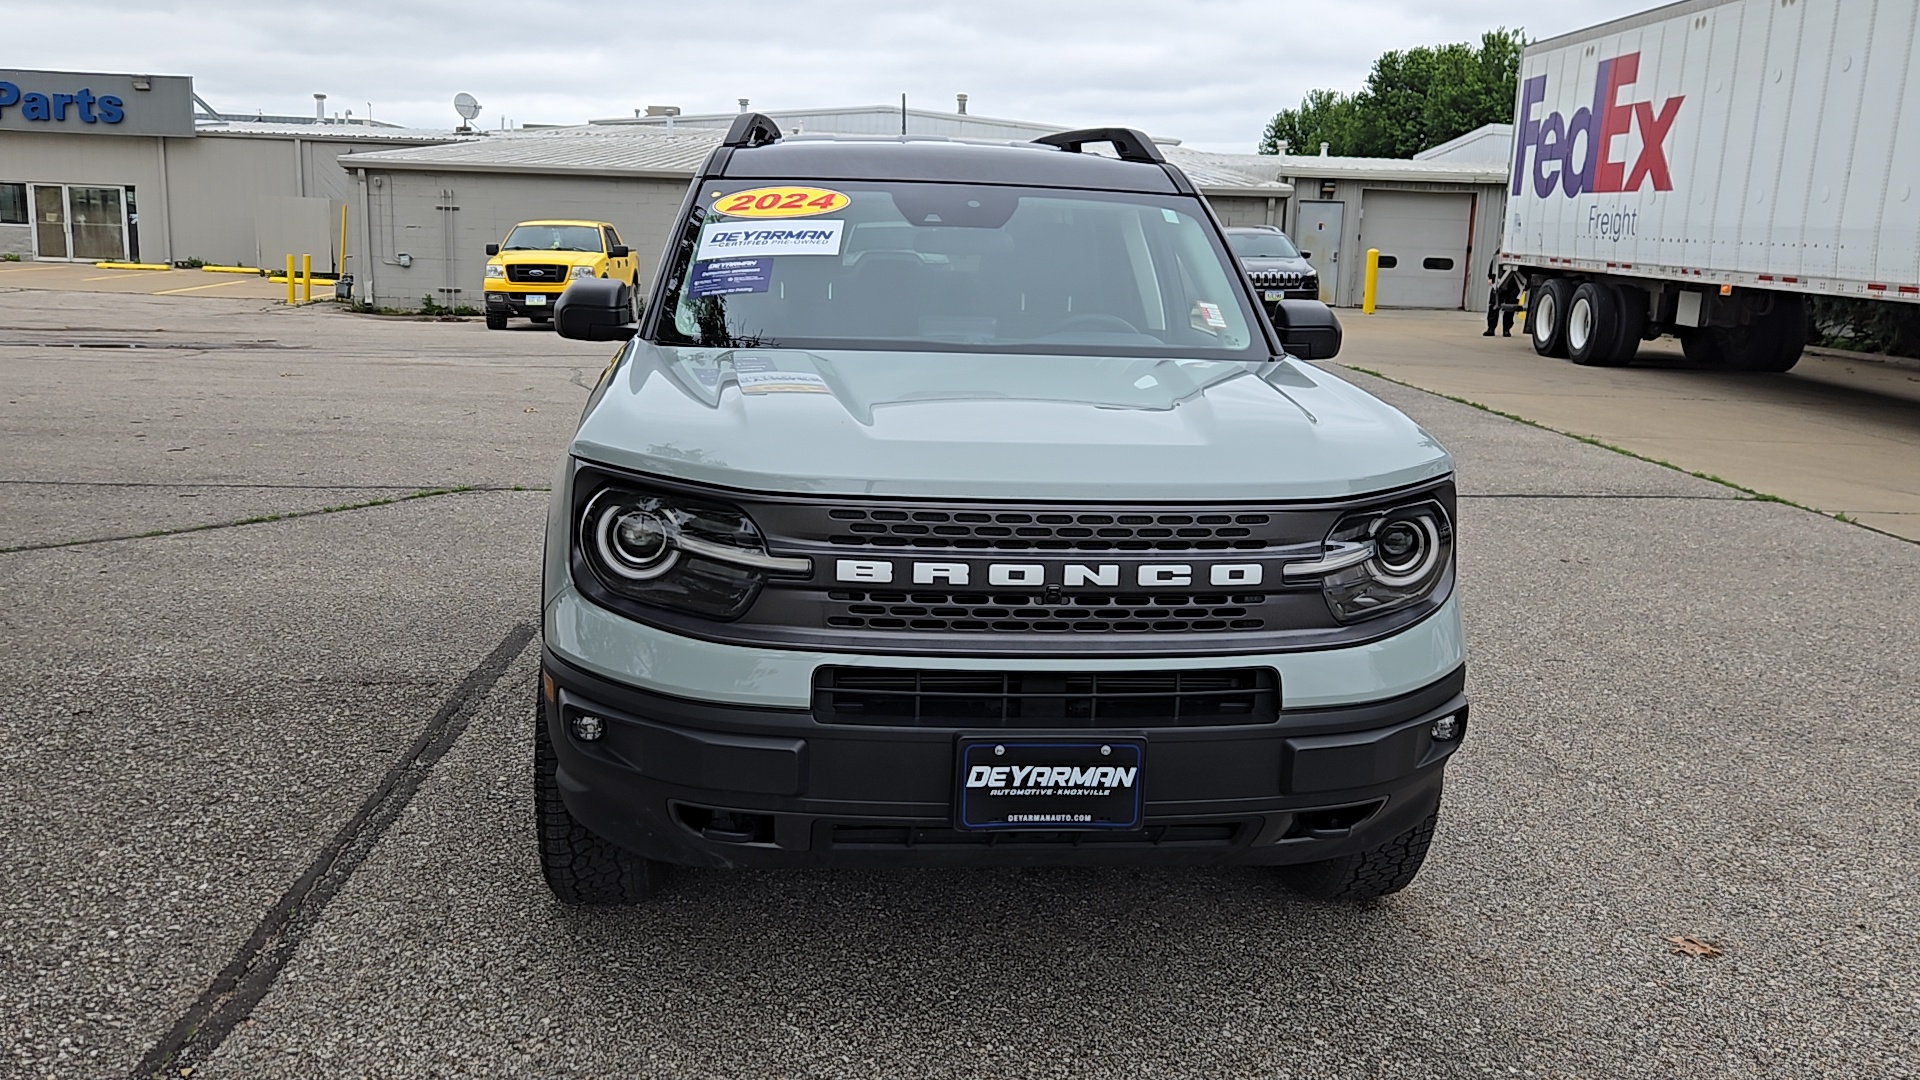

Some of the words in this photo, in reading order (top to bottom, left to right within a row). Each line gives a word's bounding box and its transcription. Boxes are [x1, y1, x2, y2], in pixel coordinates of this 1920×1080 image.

[0, 81, 125, 124] Parts
[1512, 51, 1686, 198] FedEx
[725, 193, 836, 212] 2024
[1588, 205, 1638, 242] Freight
[710, 230, 834, 243] DEYARMAN
[836, 559, 1263, 587] BRONCO
[966, 765, 1138, 788] DEYARMAN
[1007, 814, 1092, 822] DEYARMANAUTO.COM
